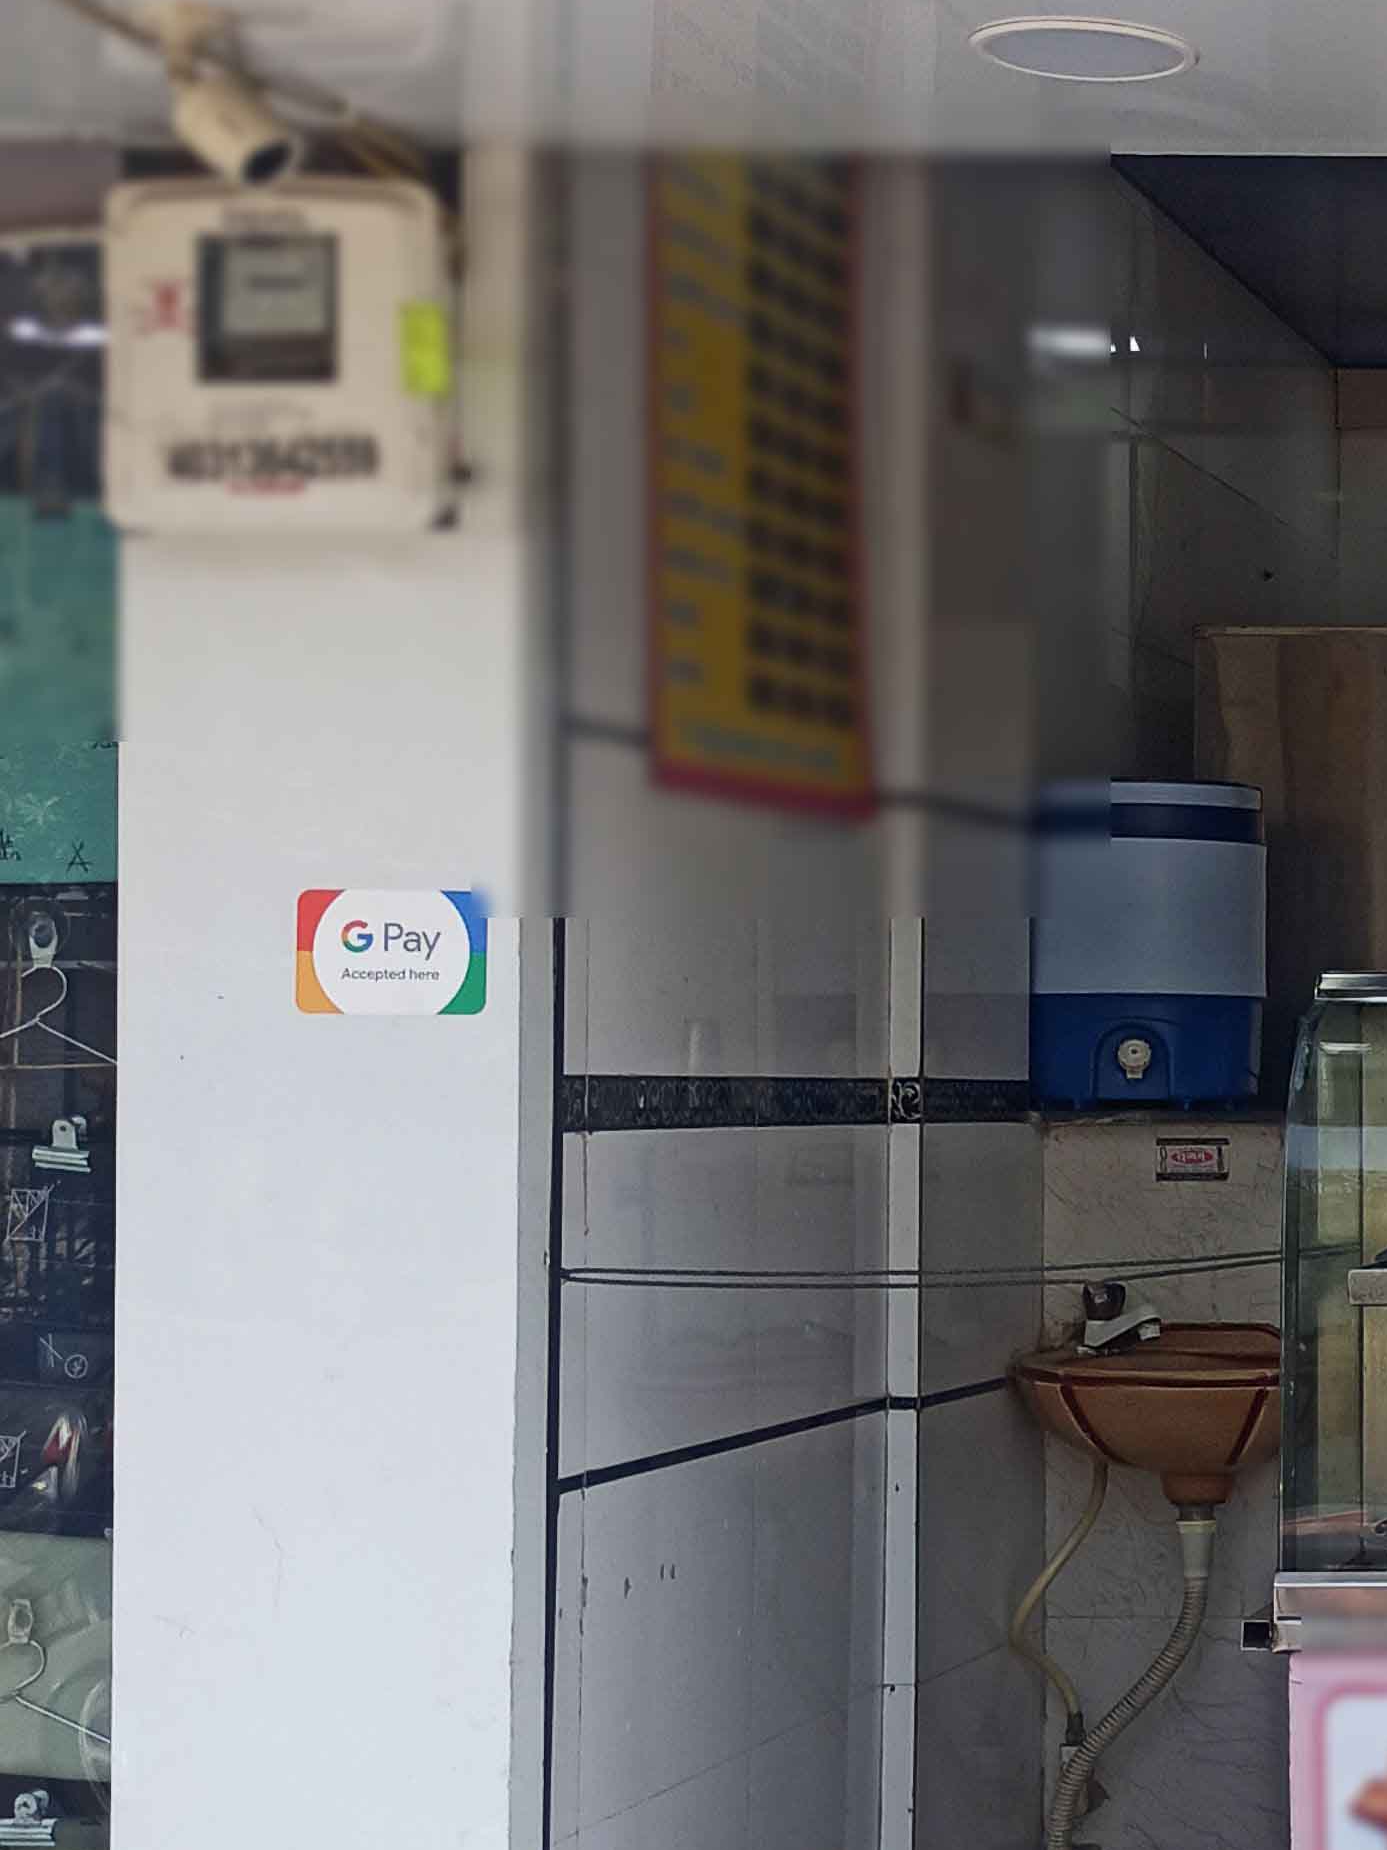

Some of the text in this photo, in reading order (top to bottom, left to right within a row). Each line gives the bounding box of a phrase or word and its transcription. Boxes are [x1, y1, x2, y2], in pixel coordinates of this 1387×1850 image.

[341, 919, 441, 961] G Pay
[341, 967, 440, 983] Accepted here
